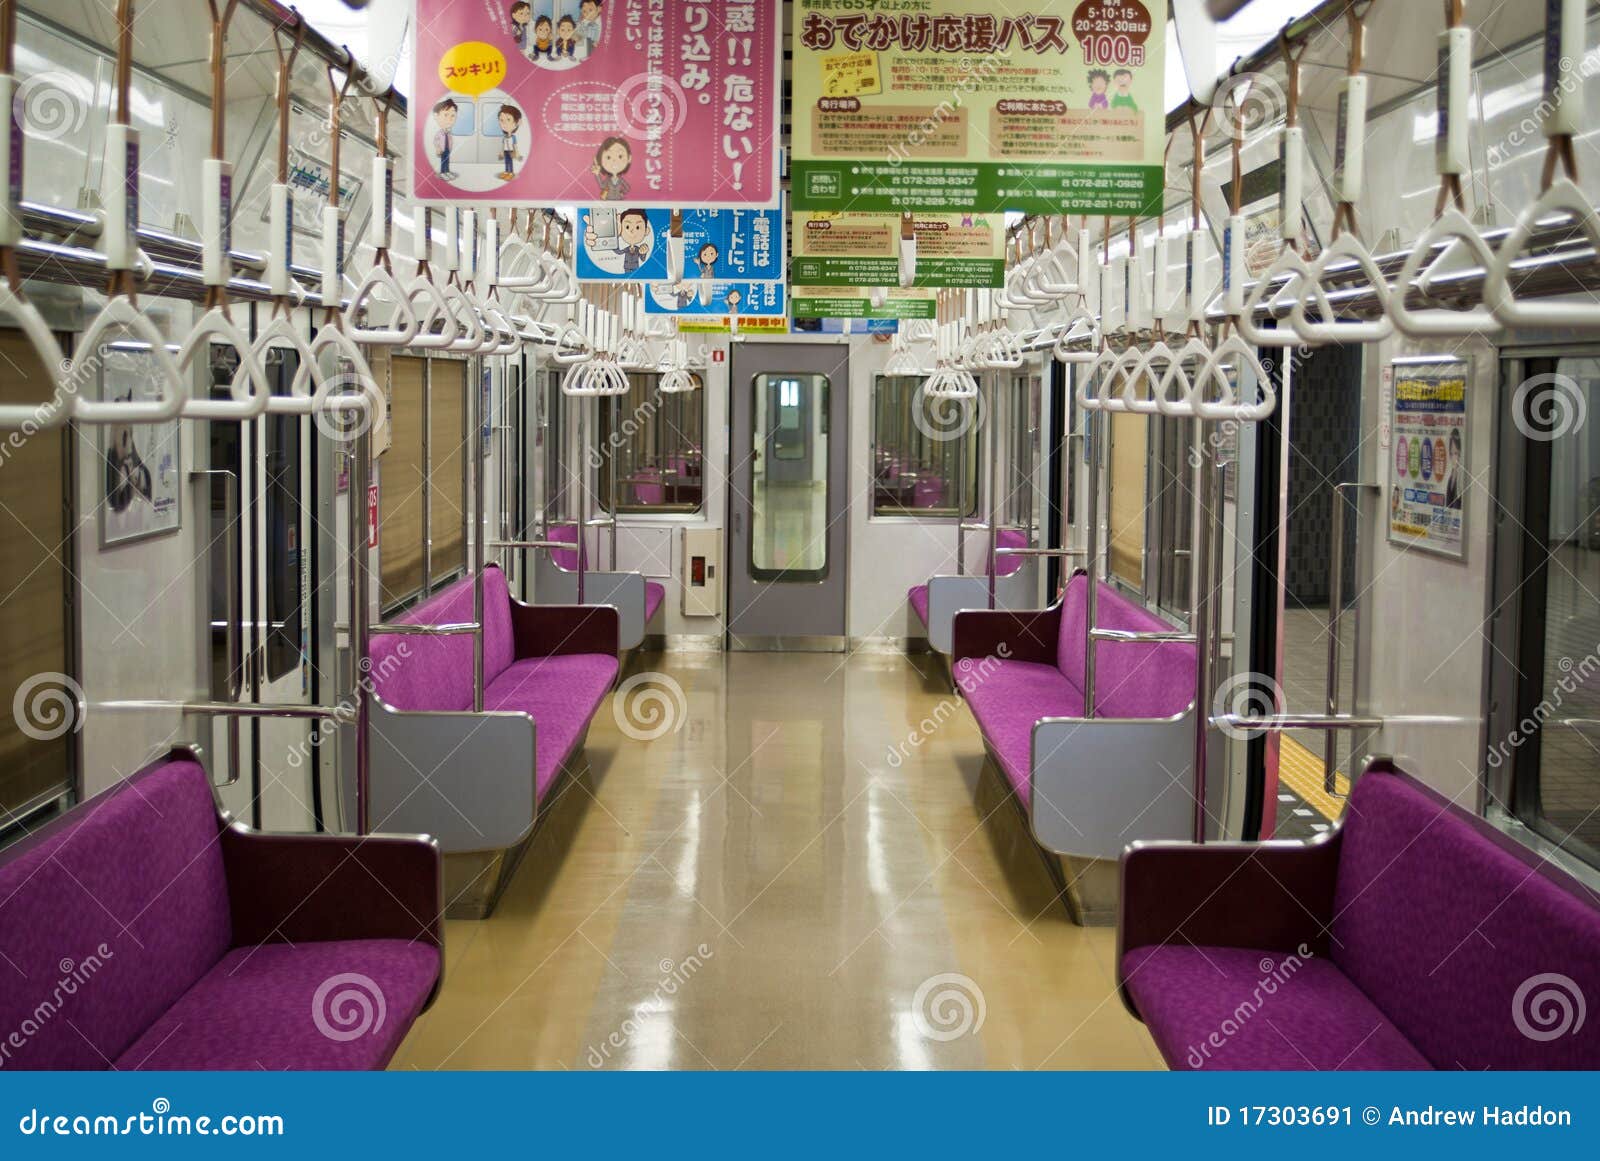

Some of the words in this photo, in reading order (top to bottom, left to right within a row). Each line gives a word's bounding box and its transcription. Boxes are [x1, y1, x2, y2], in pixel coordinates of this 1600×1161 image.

[680, 0, 711, 104] り込み。
[801, 12, 1069, 54] おでかけ応援バス
[1081, 34, 1145, 66] 100円
[723, 0, 756, 190] 惑!!危ない!
